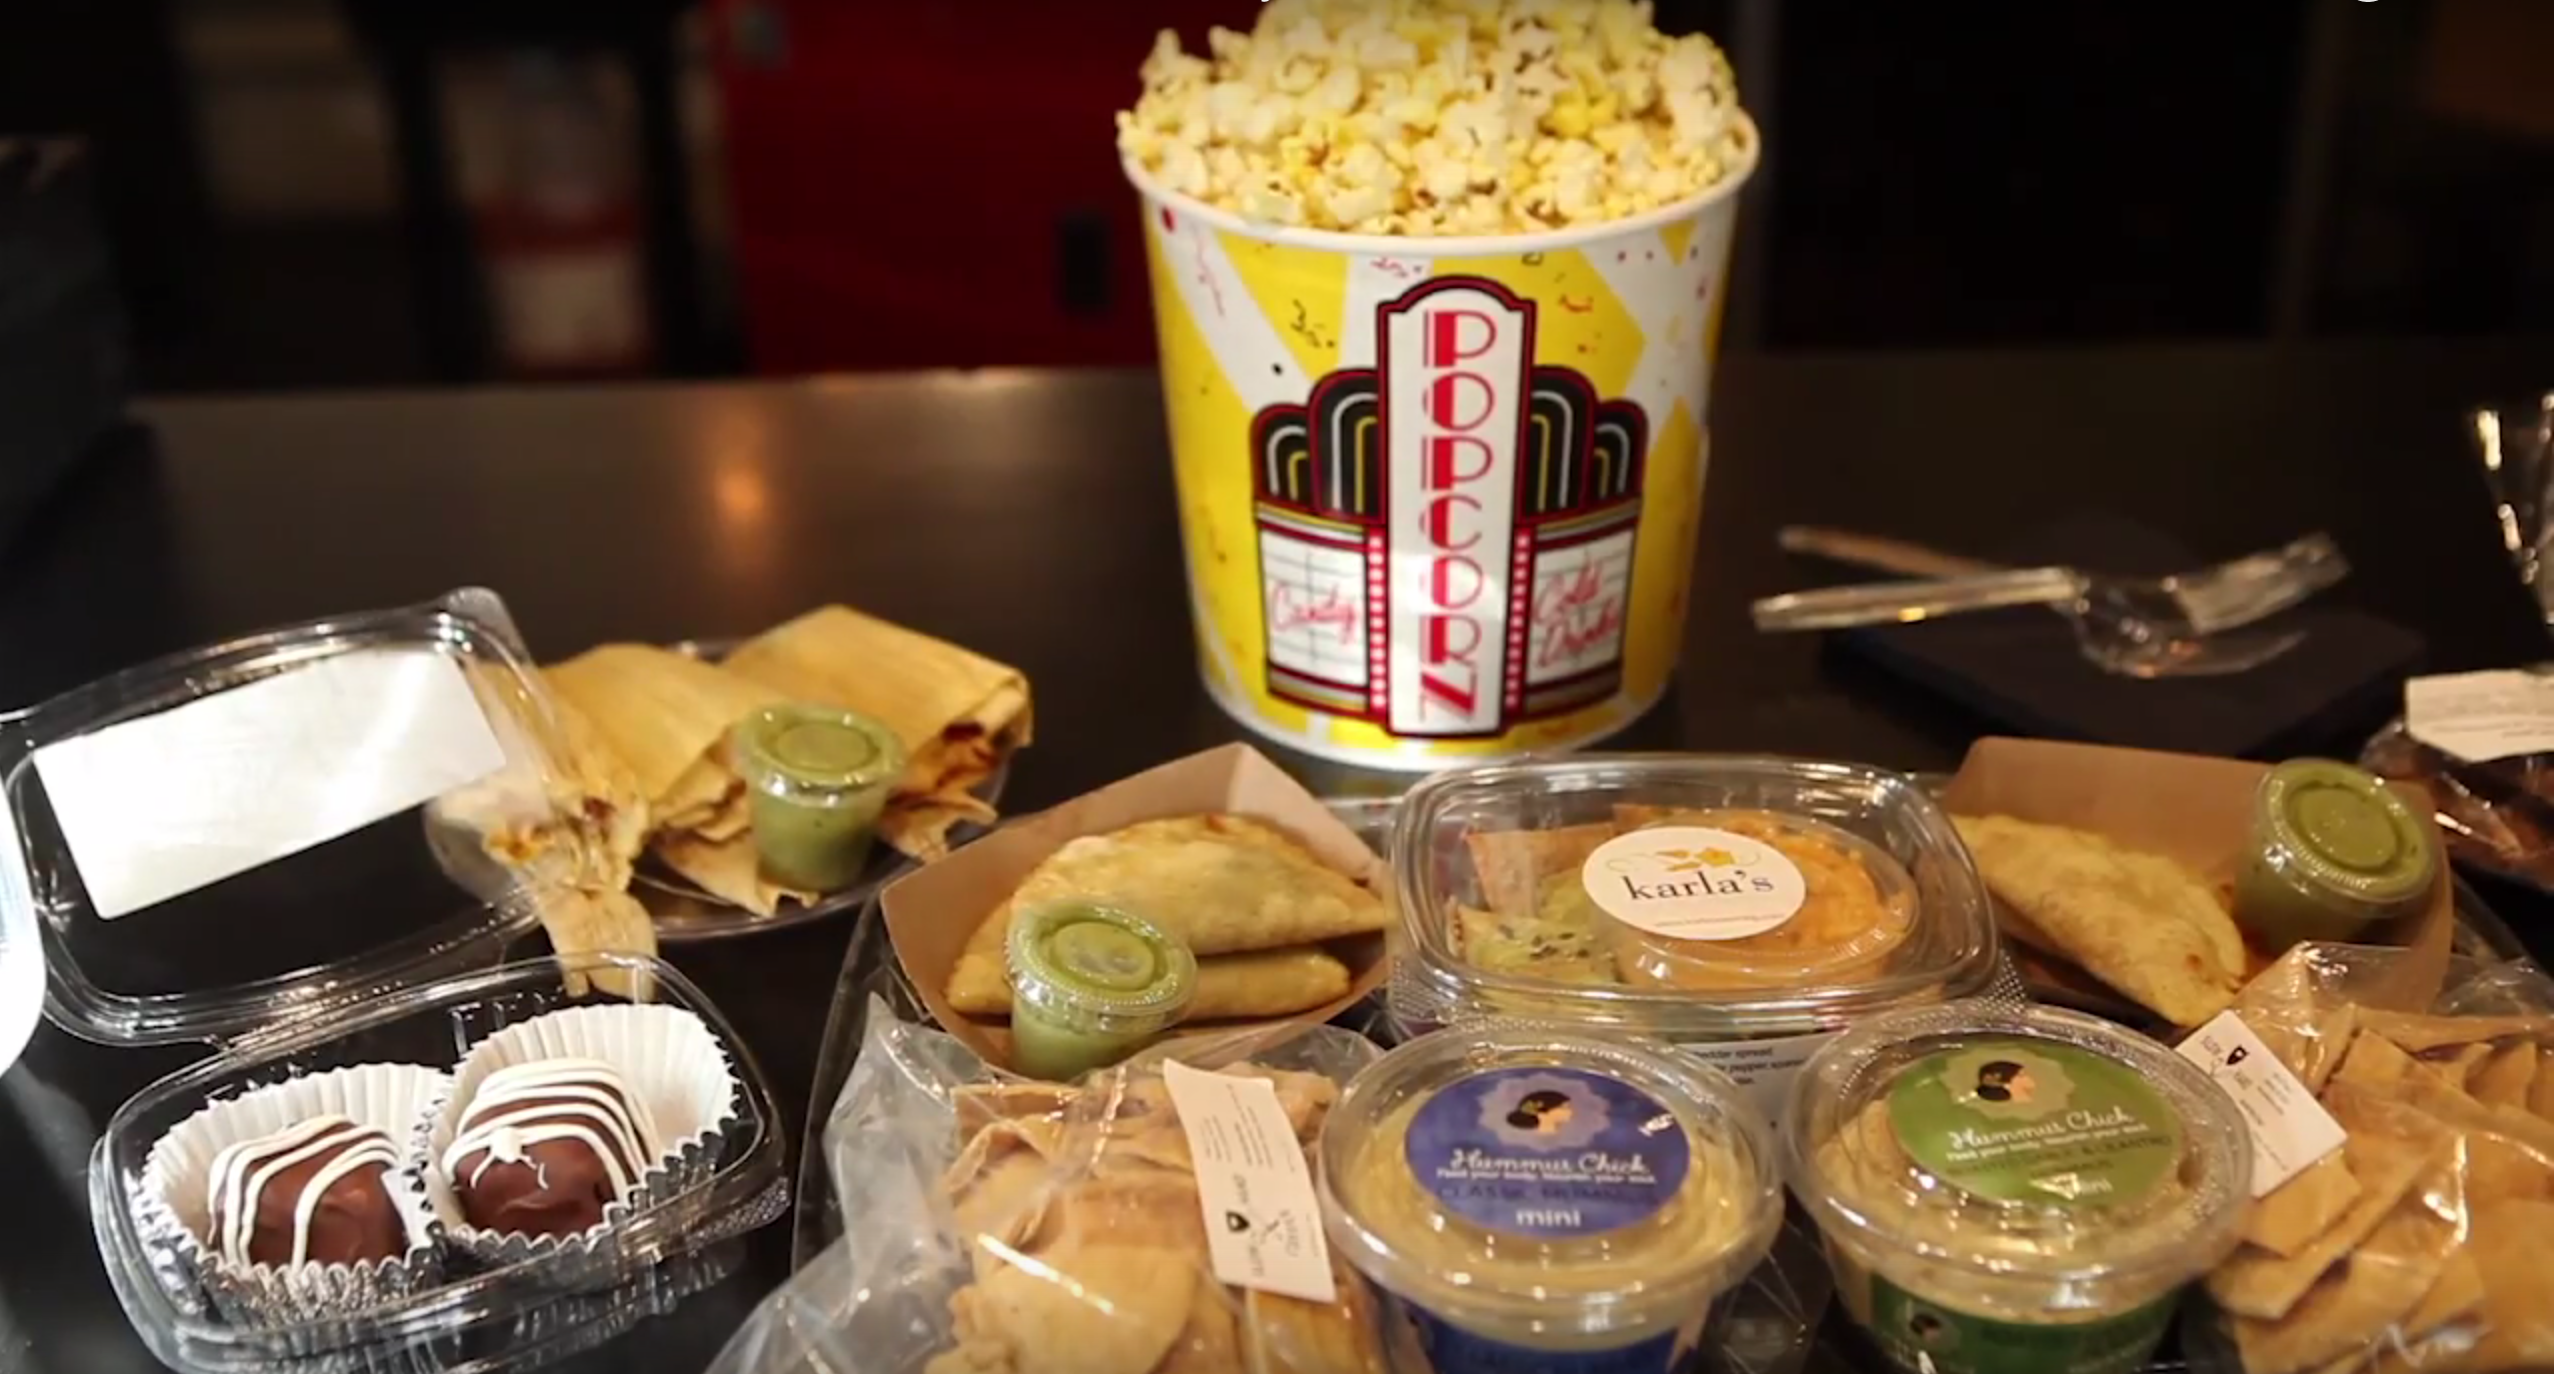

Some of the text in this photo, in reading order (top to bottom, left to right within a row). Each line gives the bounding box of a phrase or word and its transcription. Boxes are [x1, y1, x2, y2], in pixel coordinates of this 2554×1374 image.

[1419, 309, 1498, 723] POPCORN
[1271, 579, 1356, 646] Candy
[1621, 869, 1776, 901] karla's
[1947, 1105, 2135, 1149] Hummus Chick
[1449, 1148, 1651, 1175] Hummus Chick
[1515, 1208, 1583, 1228] mini
